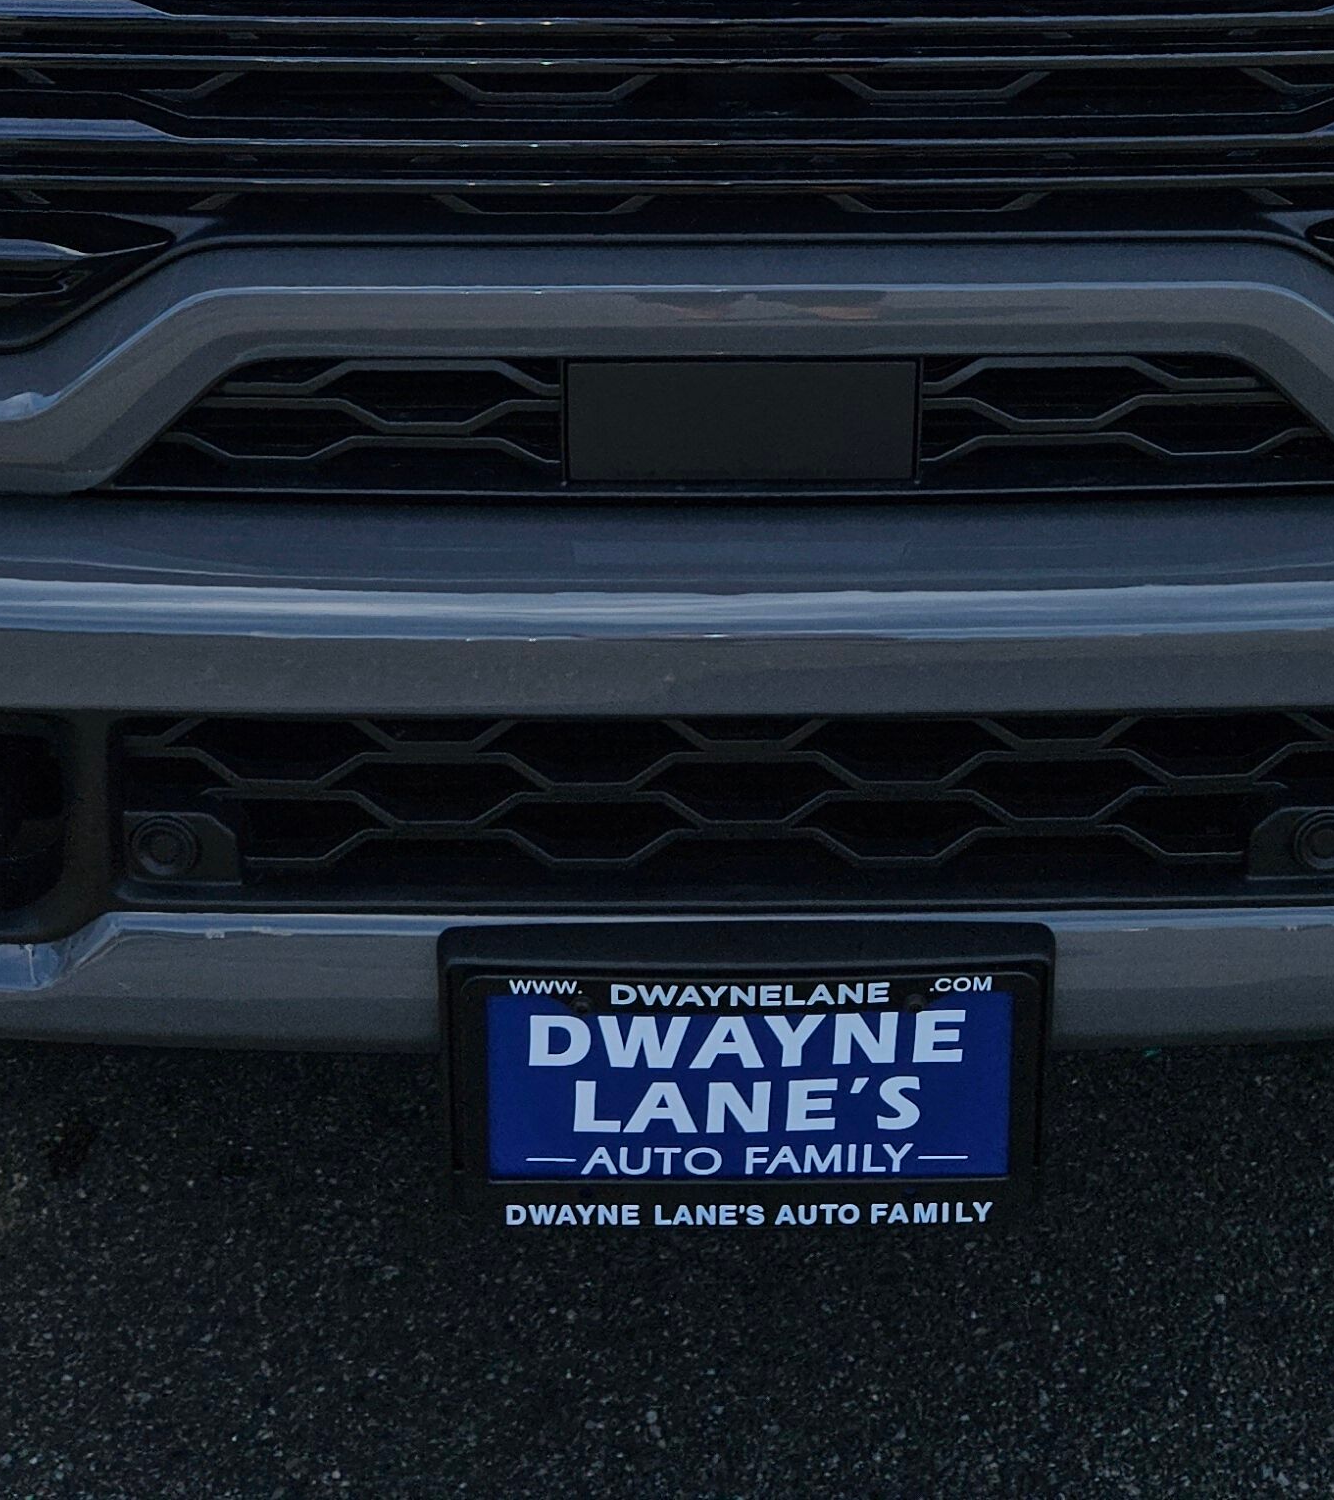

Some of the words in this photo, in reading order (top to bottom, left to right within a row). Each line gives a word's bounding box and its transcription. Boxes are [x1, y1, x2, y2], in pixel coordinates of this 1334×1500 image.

[610, 981, 892, 1008] DWAYNELANE
[929, 976, 994, 994] .COM
[528, 1009, 968, 1070] DWAYNE
[573, 1076, 922, 1135] LANE'S
[581, 1146, 724, 1177] AUTO
[745, 1143, 915, 1176] FAMILY
[506, 1204, 642, 1227] DWAYNE
[654, 1204, 766, 1227] LANE'S
[774, 1203, 862, 1227] AUTO
[870, 1201, 995, 1226] FAMILY
